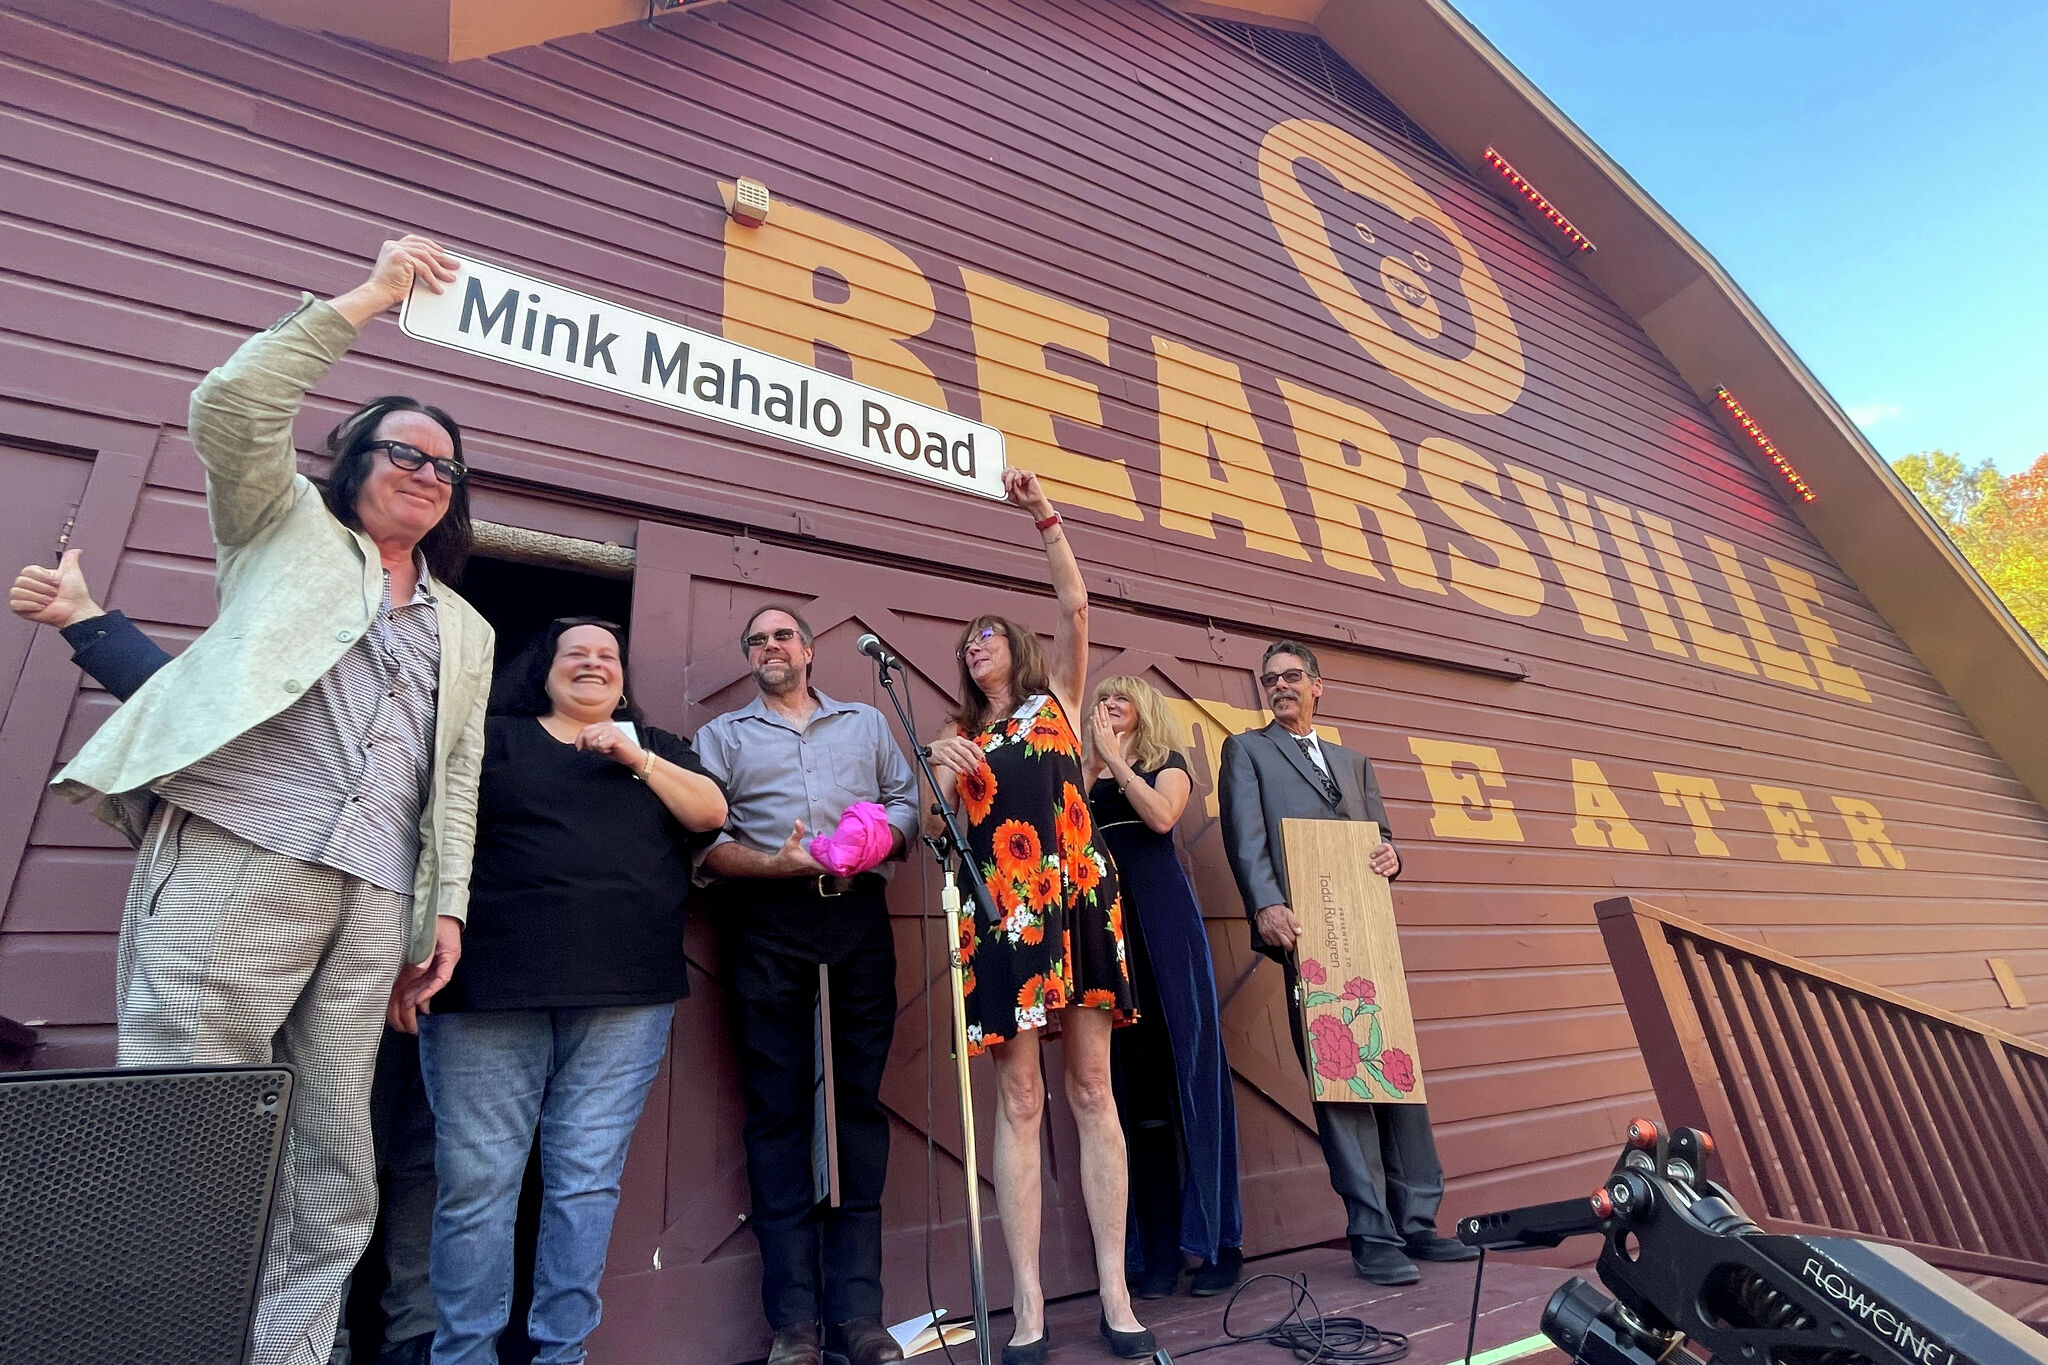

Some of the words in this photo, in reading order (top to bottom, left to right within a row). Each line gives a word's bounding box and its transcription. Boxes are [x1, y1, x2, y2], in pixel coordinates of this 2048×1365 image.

[459, 276, 618, 376] Mink
[642, 331, 843, 438] Mahalo
[861, 400, 977, 479] Road
[716, 181, 1874, 704] BEARSVILLE
[1161, 697, 1906, 870] TEATER
[1319, 872, 1334, 902] Todd
[1324, 907, 1340, 968] Rundgren
[1803, 1258, 1942, 1365] FLOWCINE
